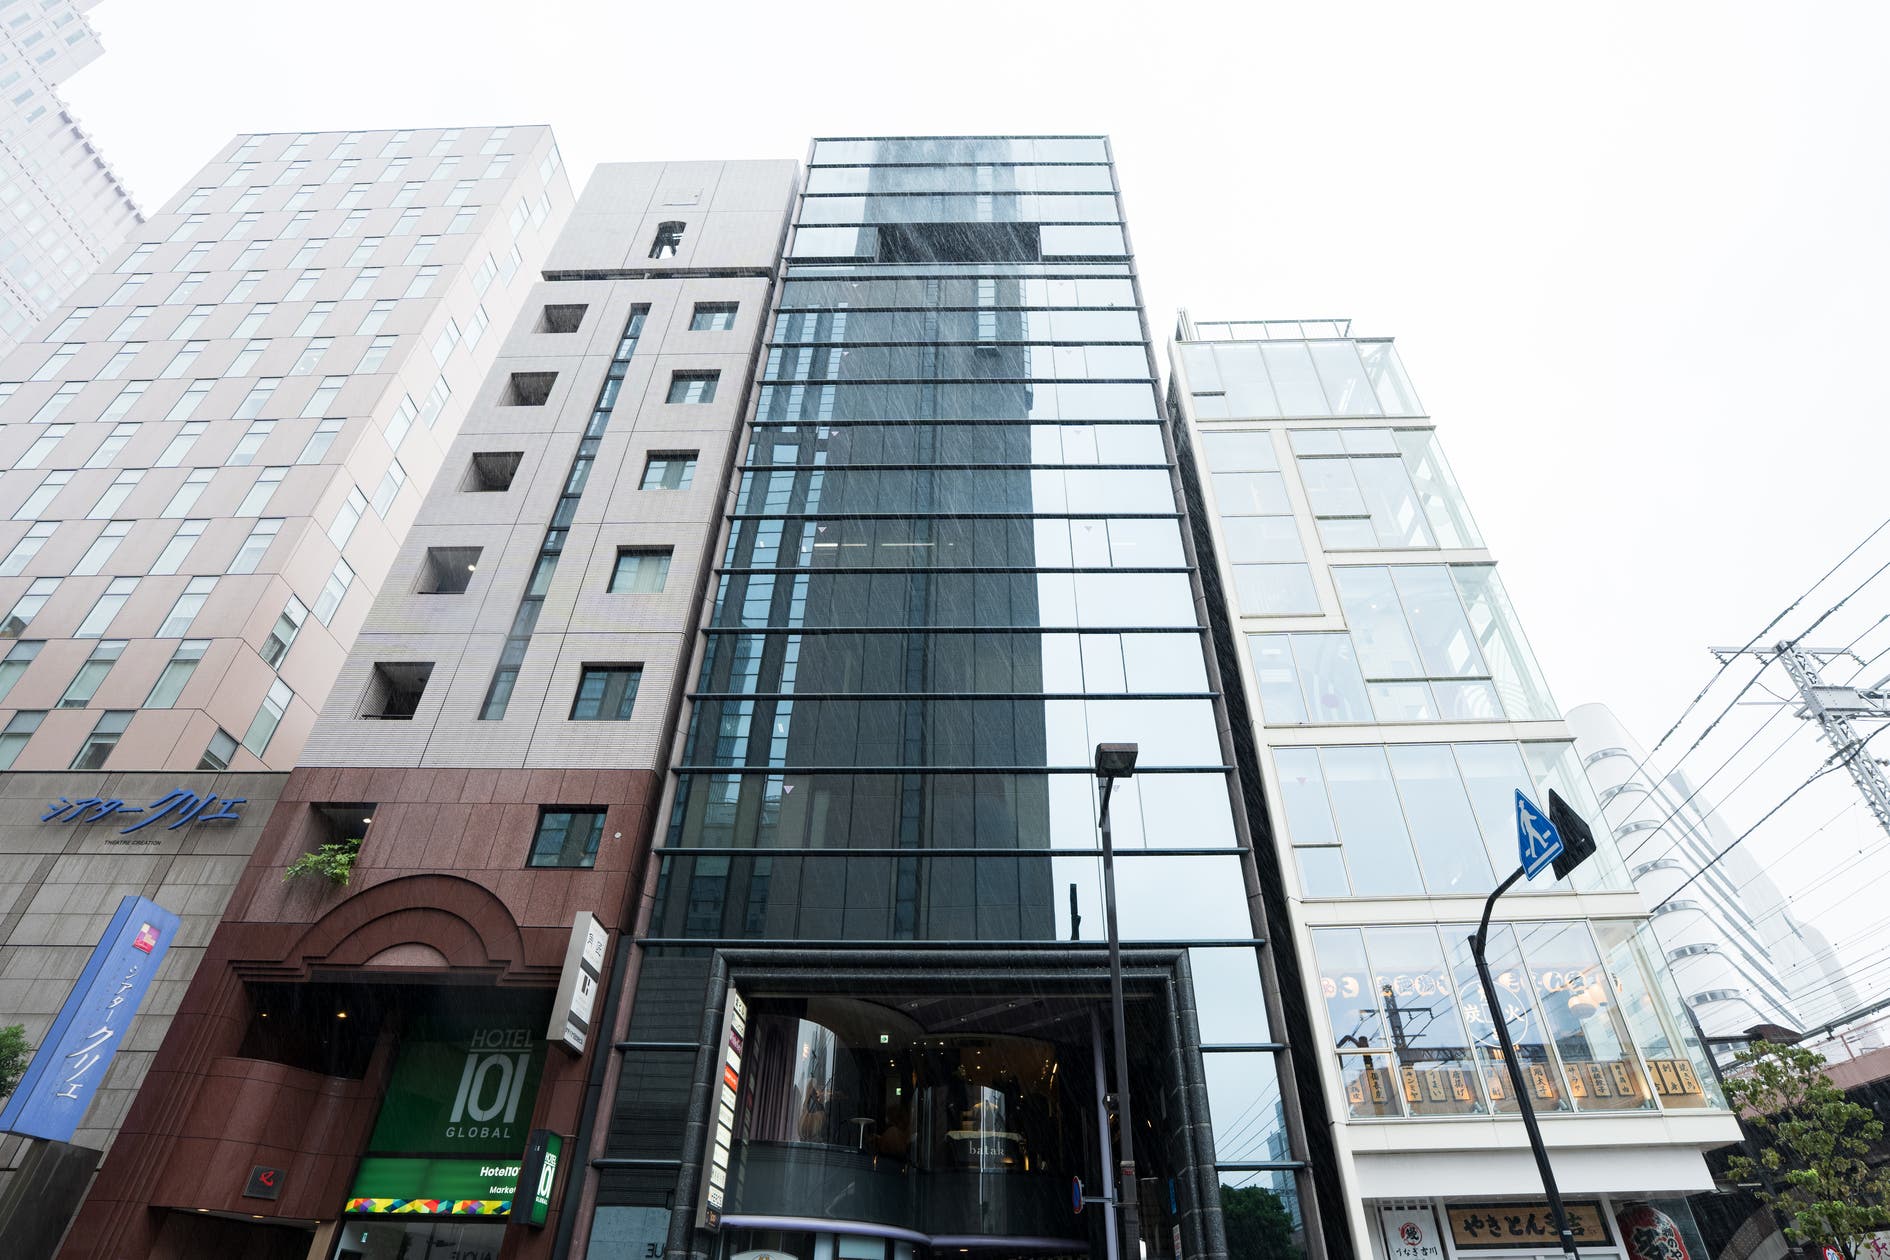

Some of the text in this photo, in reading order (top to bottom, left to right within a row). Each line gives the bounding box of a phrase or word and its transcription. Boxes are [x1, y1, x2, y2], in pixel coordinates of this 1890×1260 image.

[40, 787, 246, 834] シアタークリエ
[56, 965, 139, 1099] シアタークリエ
[471, 1029, 533, 1048] HOTEL
[446, 1127, 511, 1139] GLOBAL
[480, 1166, 521, 1177] Hotel10
